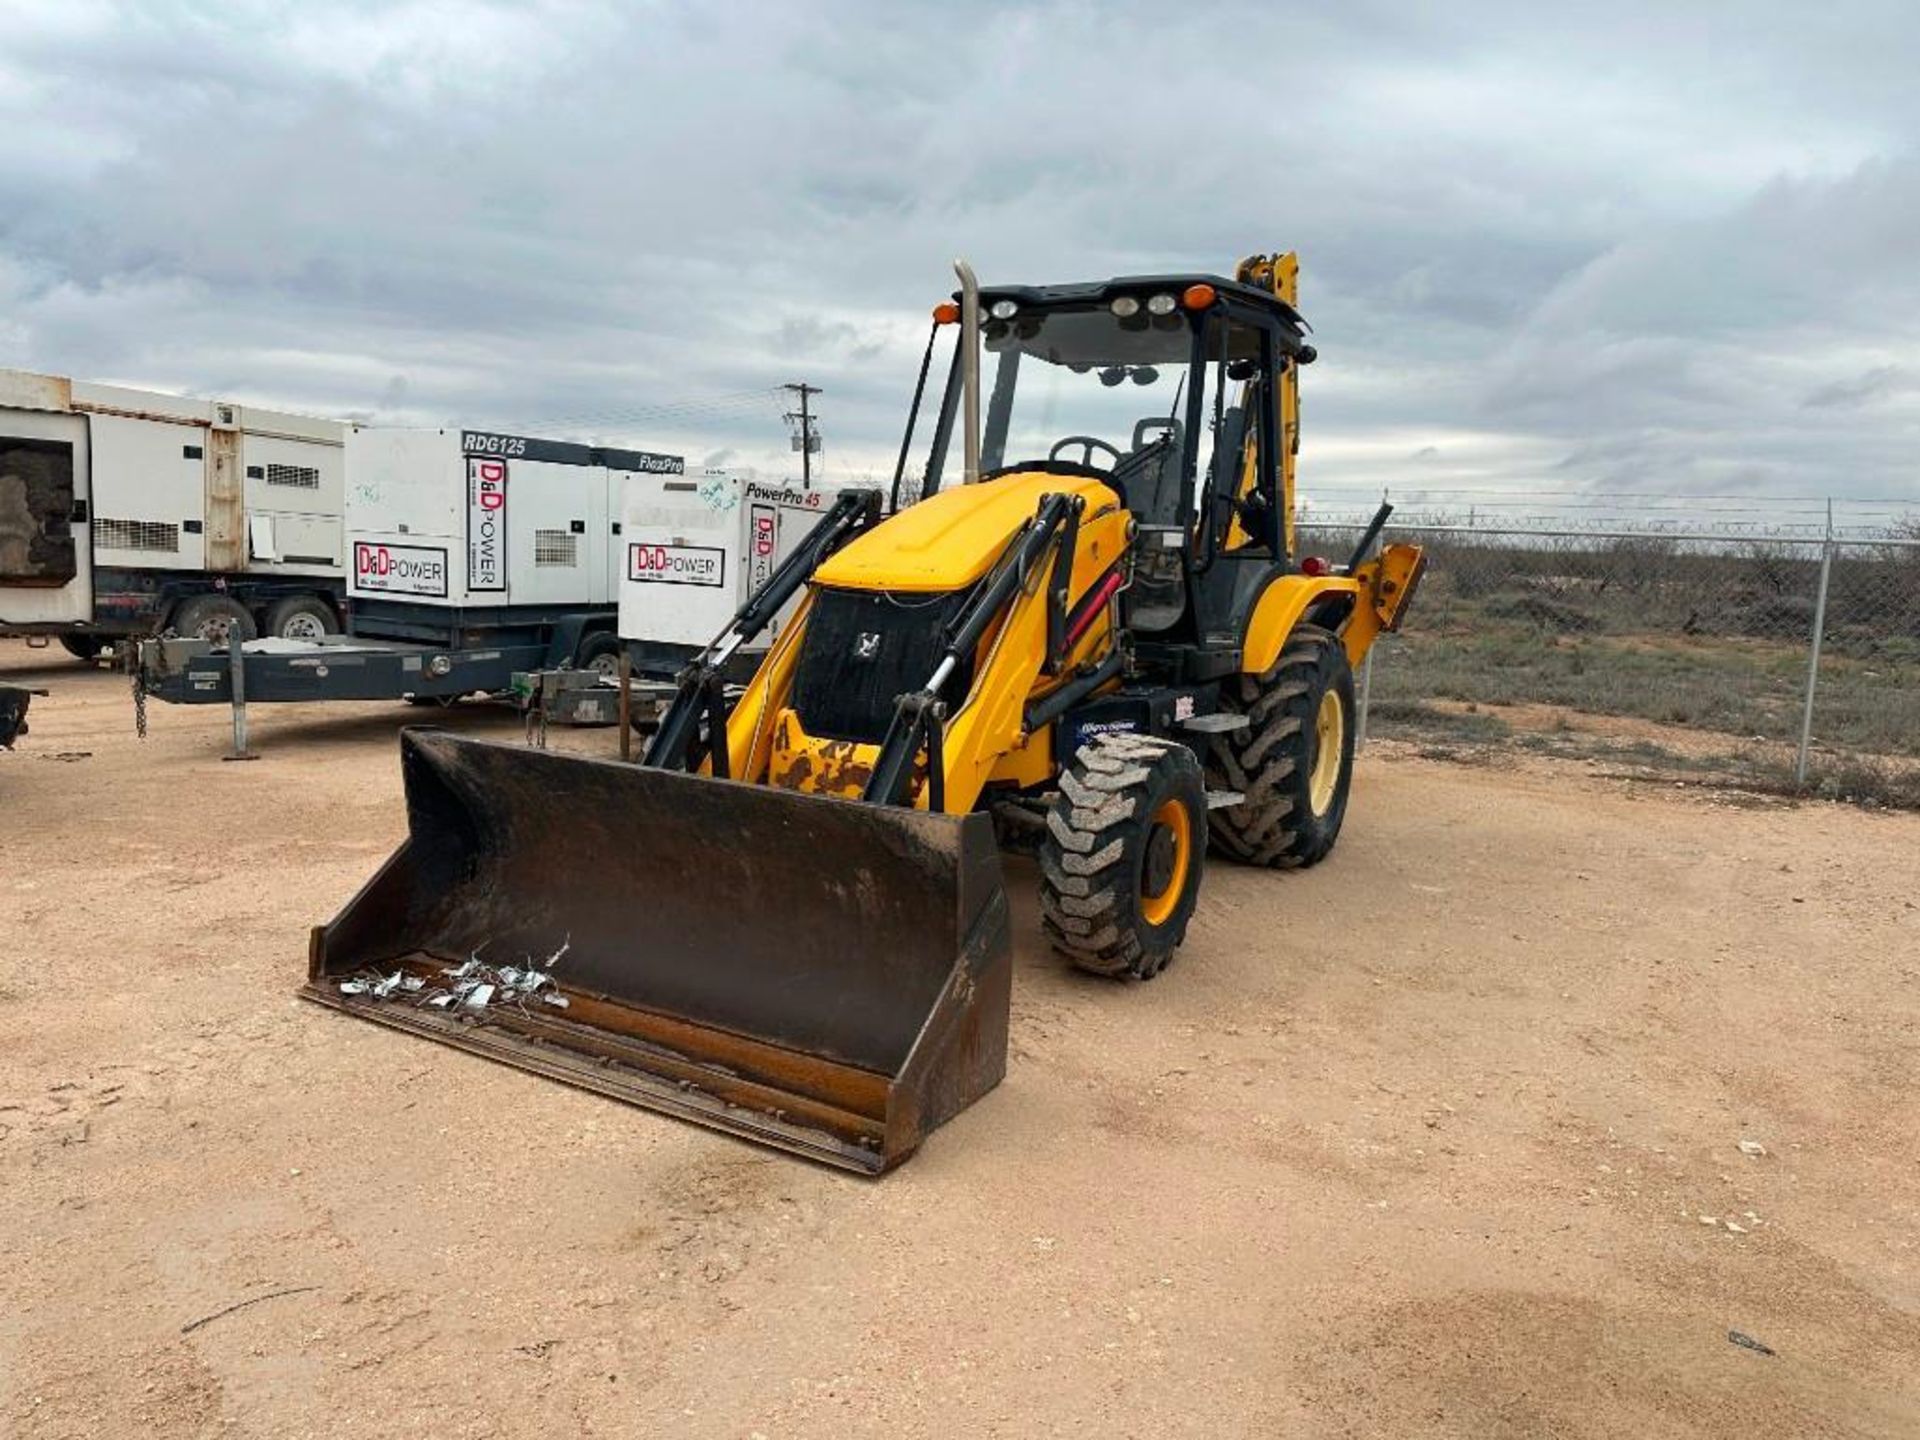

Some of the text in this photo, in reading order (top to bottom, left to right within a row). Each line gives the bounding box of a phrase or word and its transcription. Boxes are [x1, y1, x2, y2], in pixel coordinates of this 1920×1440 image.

[464, 434, 526, 455] RDG125
[745, 482, 821, 507] PowerPro 45
